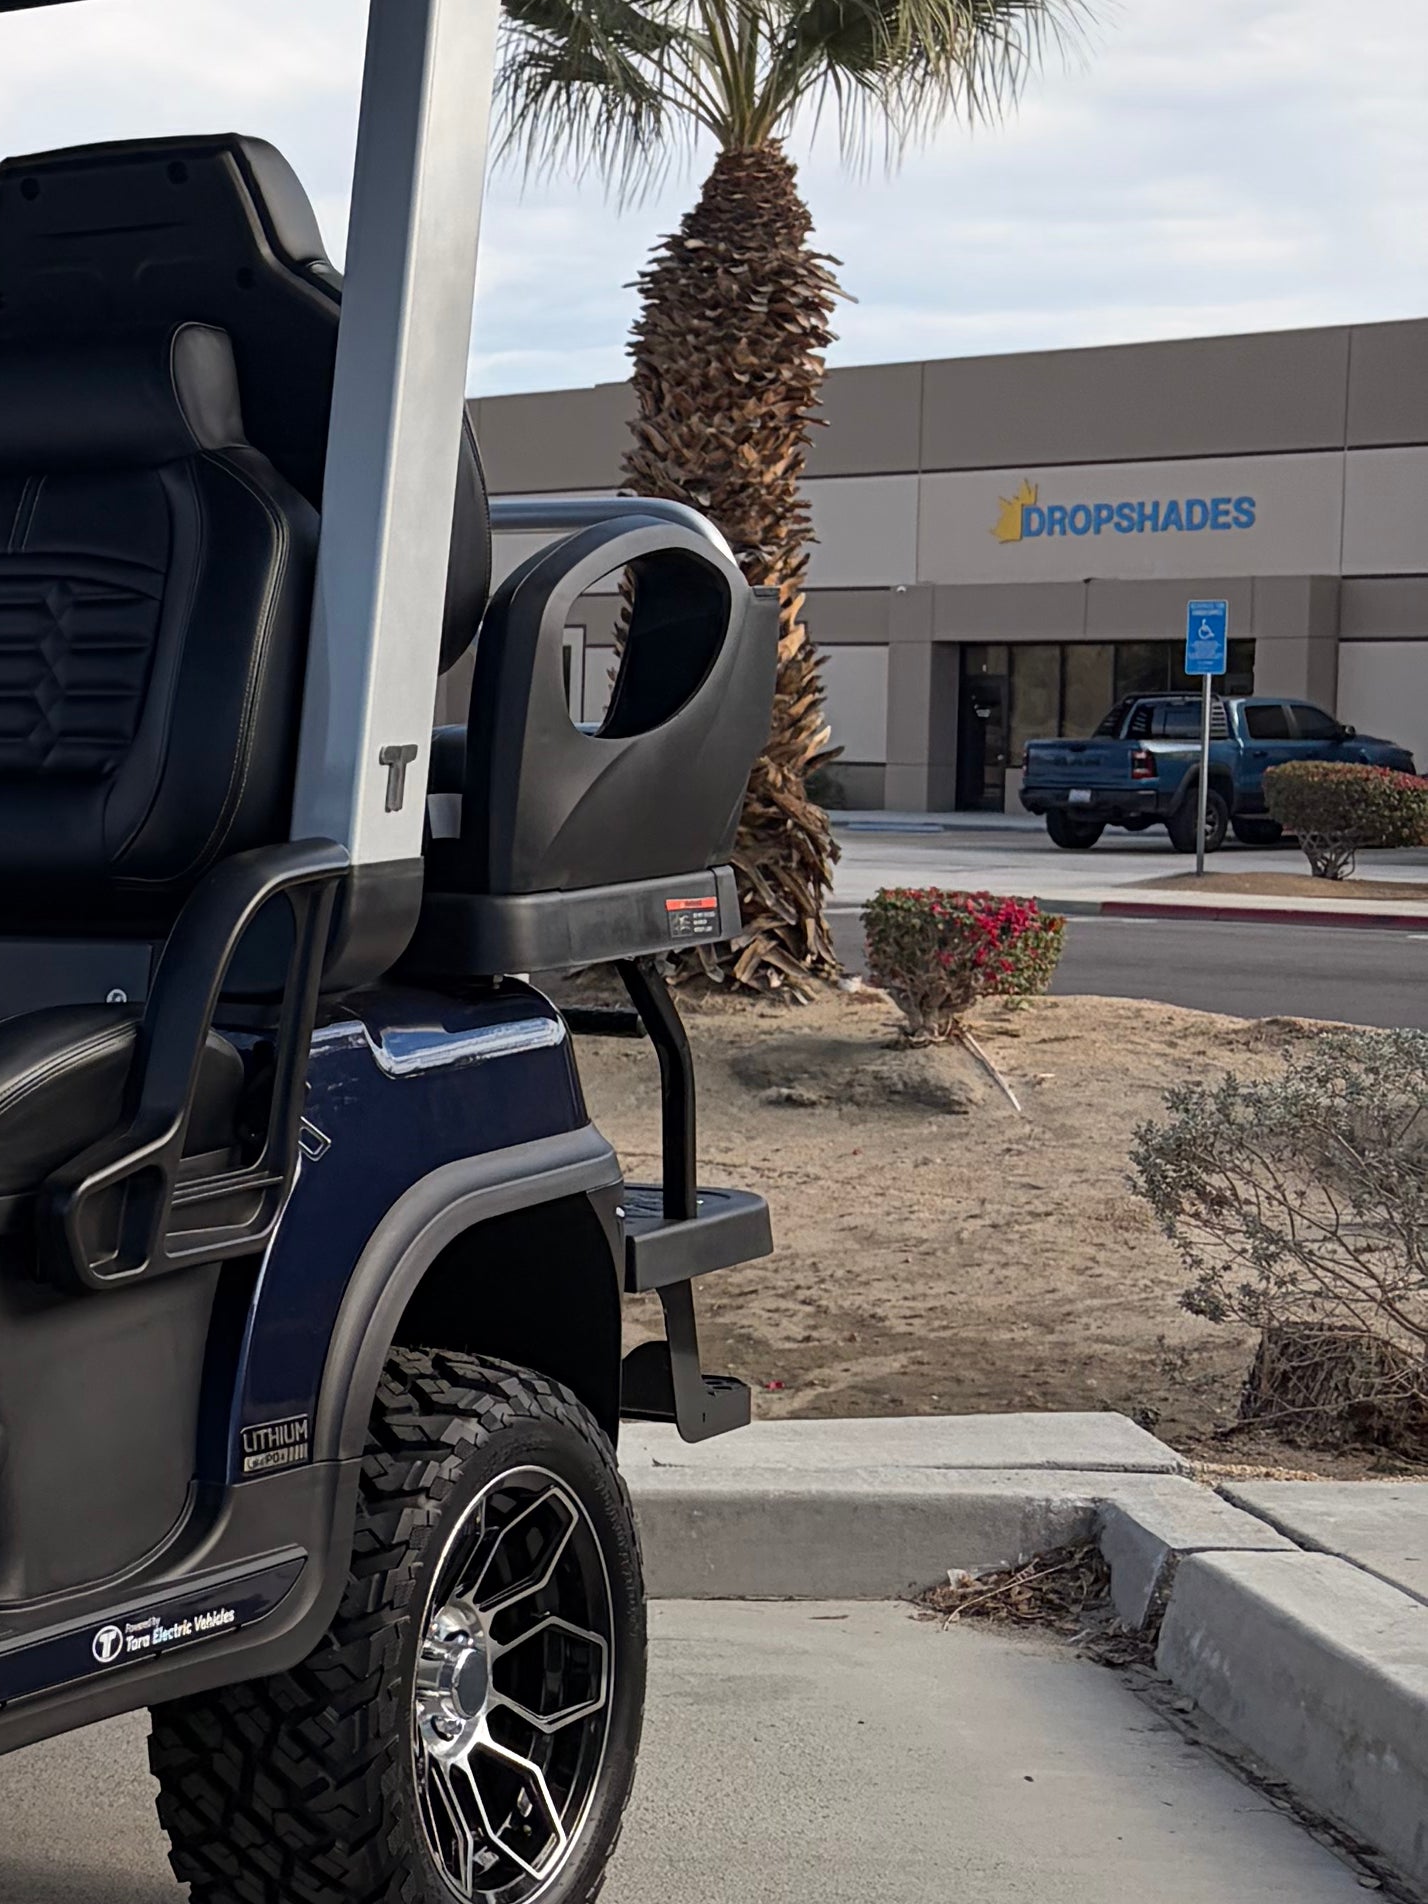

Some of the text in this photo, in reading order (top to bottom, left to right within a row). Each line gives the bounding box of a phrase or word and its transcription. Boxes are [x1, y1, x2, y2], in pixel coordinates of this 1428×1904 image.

[1021, 496, 1256, 537] DROPSHADES
[243, 1419, 308, 1453] LITHIUM
[152, 1619, 192, 1645] Electric
[193, 1608, 235, 1632] Vehicles
